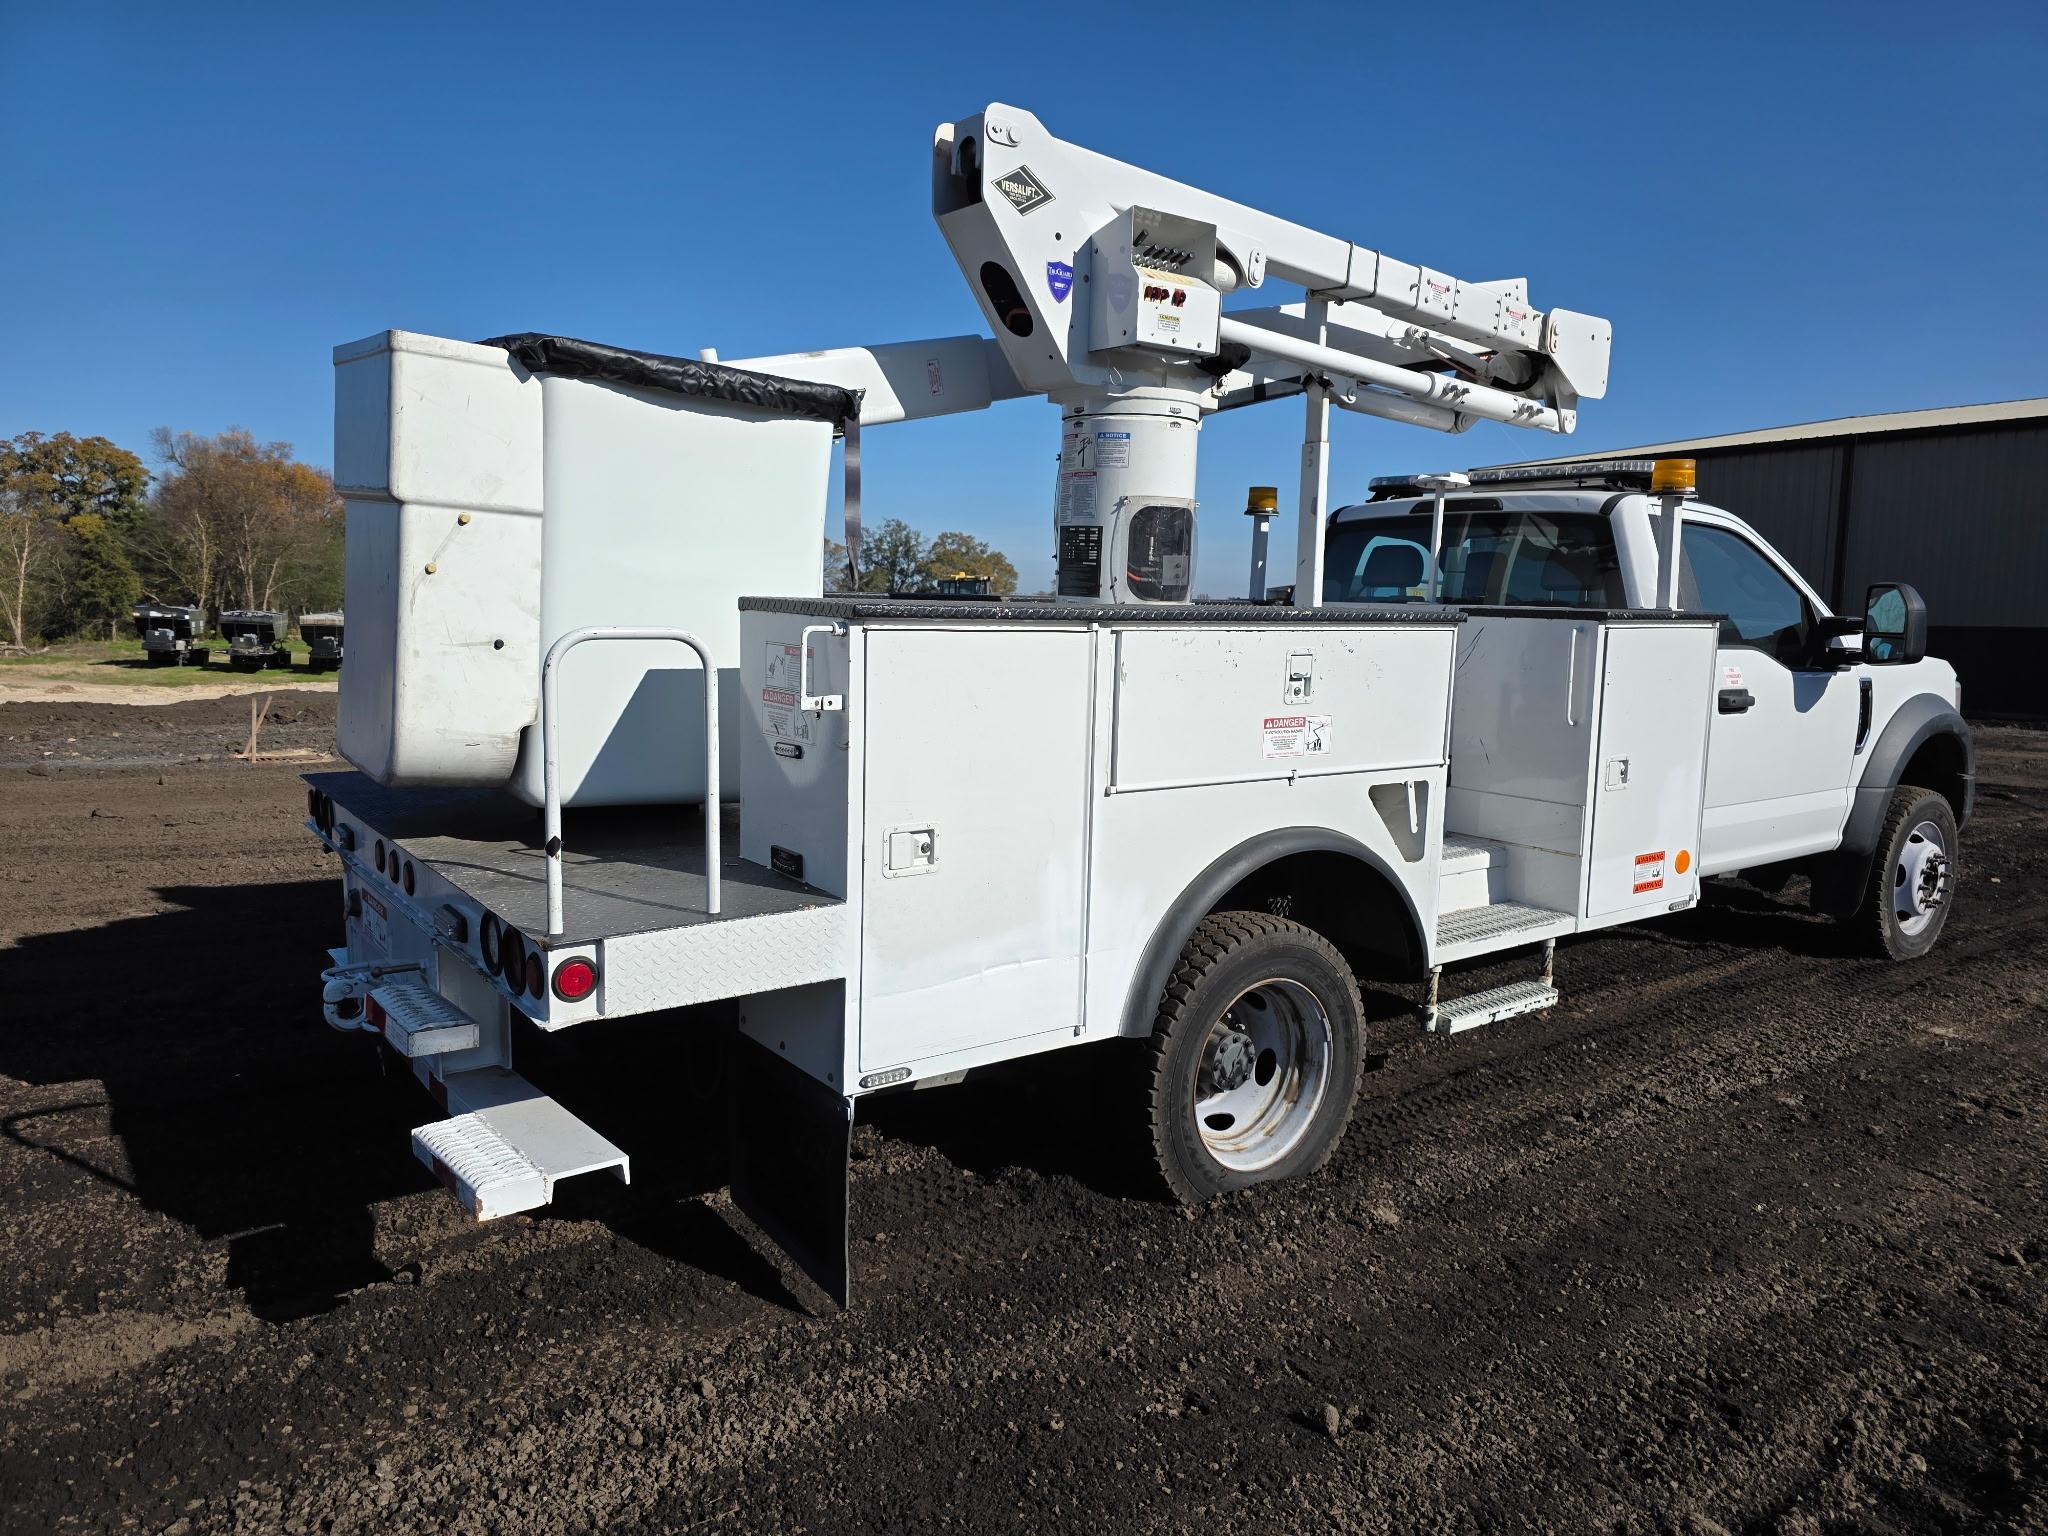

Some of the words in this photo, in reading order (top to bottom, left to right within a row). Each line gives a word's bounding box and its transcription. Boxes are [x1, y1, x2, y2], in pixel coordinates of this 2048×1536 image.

[1001, 179, 1036, 198] VERSALIFT
[769, 691, 794, 705] DANGER
[1273, 717, 1304, 728] DANGER
[1640, 853, 1664, 864] WARNING
[1639, 880, 1662, 891] WARNING
